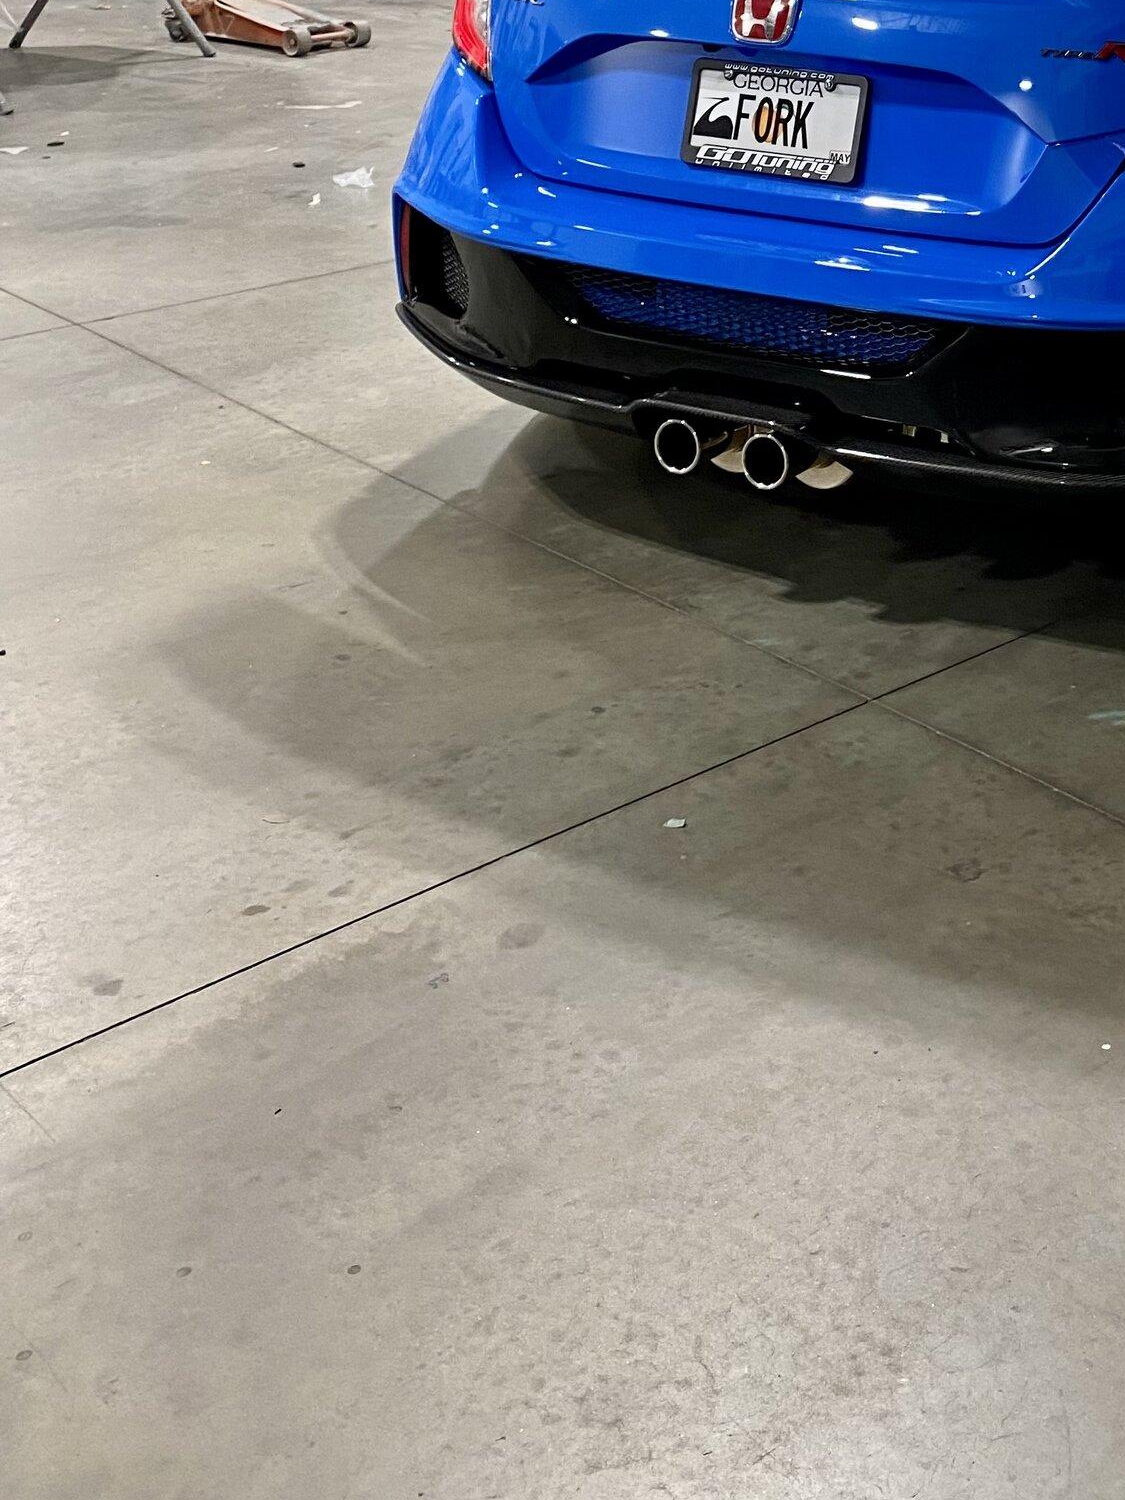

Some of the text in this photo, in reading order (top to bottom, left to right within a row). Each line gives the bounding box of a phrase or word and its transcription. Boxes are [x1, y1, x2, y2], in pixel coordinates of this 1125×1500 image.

[733, 73, 824, 98] GEORGIA
[733, 93, 815, 149] FORK
[831, 152, 850, 165] MAY
